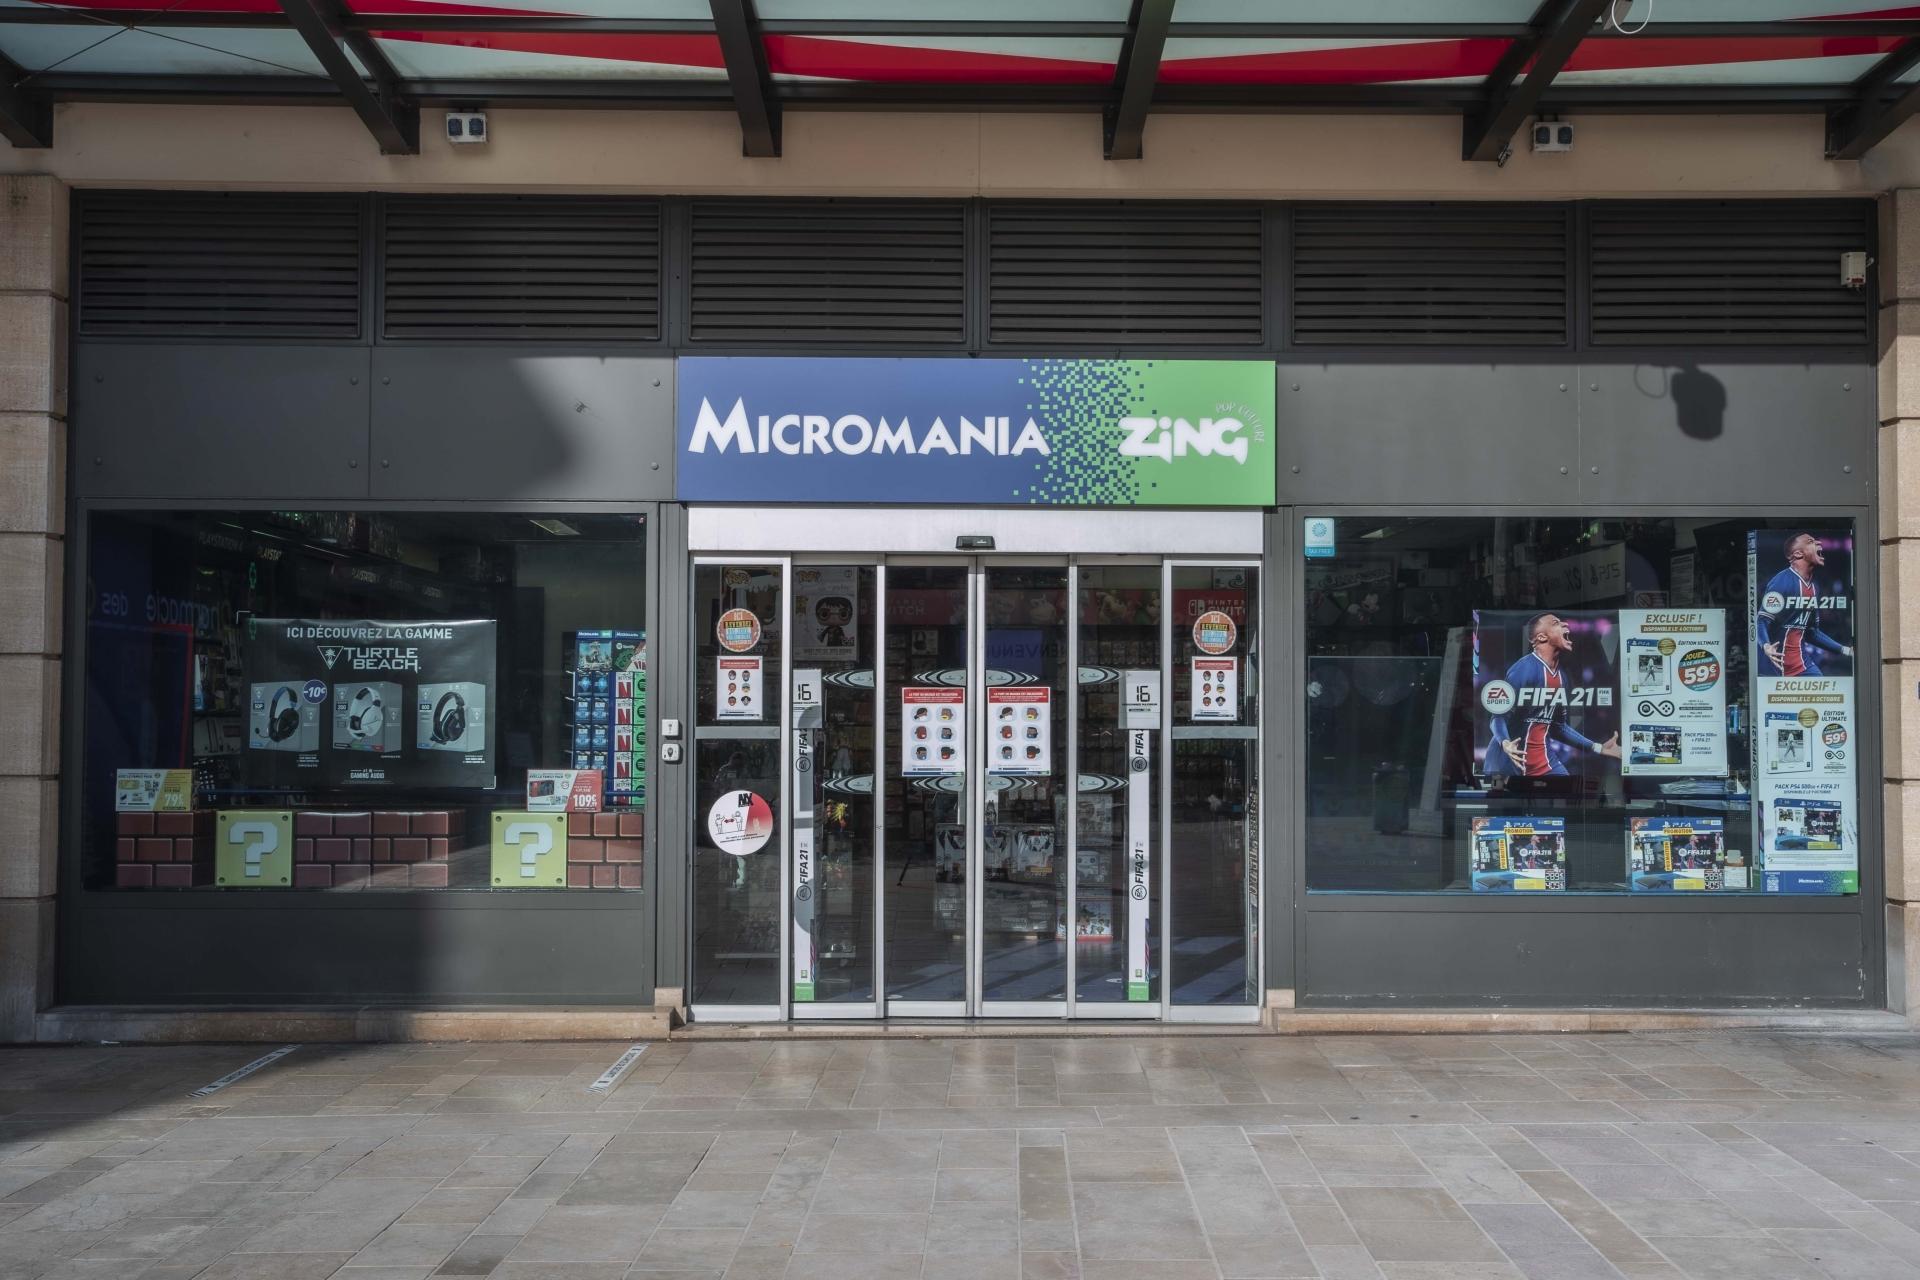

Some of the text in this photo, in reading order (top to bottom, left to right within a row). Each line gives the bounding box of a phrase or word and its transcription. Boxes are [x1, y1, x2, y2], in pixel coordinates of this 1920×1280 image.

[1215, 401, 1236, 413] POP
[1785, 596, 1835, 609] FIFA 21
[1645, 613, 1697, 624] EXCLUSIF
[287, 624, 453, 639] ICI DÉCOUVREZ LA GAMME
[343, 647, 418, 662] TURTLE
[1684, 650, 1706, 661] JOUEZ
[798, 683, 812, 701] 16
[1136, 685, 1151, 702] 16
[1488, 687, 1509, 699] EA
[1775, 681, 1830, 691] EXCLUSIF
[1517, 687, 1595, 707] FIFA 21
[799, 731, 808, 756] FIFA
[1135, 732, 1144, 756] FIFA
[800, 849, 809, 884] FIFA 21
[1134, 849, 1144, 884] FIFA 21
